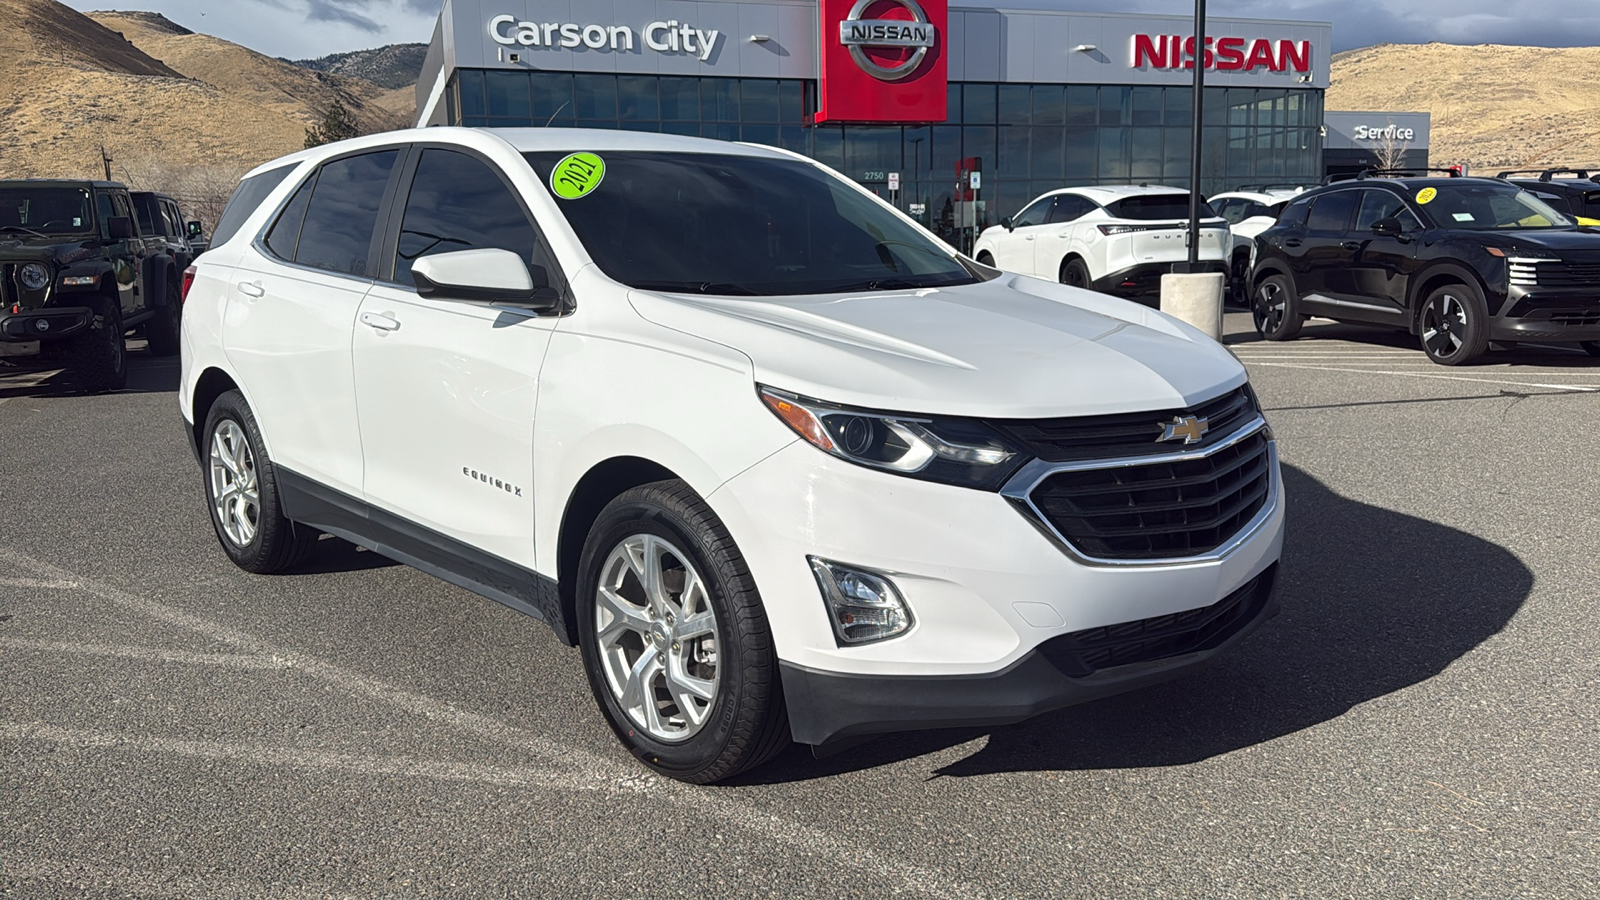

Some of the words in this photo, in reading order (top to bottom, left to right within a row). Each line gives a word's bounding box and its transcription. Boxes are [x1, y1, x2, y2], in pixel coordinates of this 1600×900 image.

[488, 14, 633, 50] Carson
[642, 18, 719, 61] City
[851, 22, 929, 42] NISSAN
[1134, 34, 1310, 72] NISSAN
[1358, 124, 1414, 140] Service
[559, 157, 597, 192] 2021
[865, 171, 884, 180] 2750
[462, 465, 524, 498] EQUINOX
